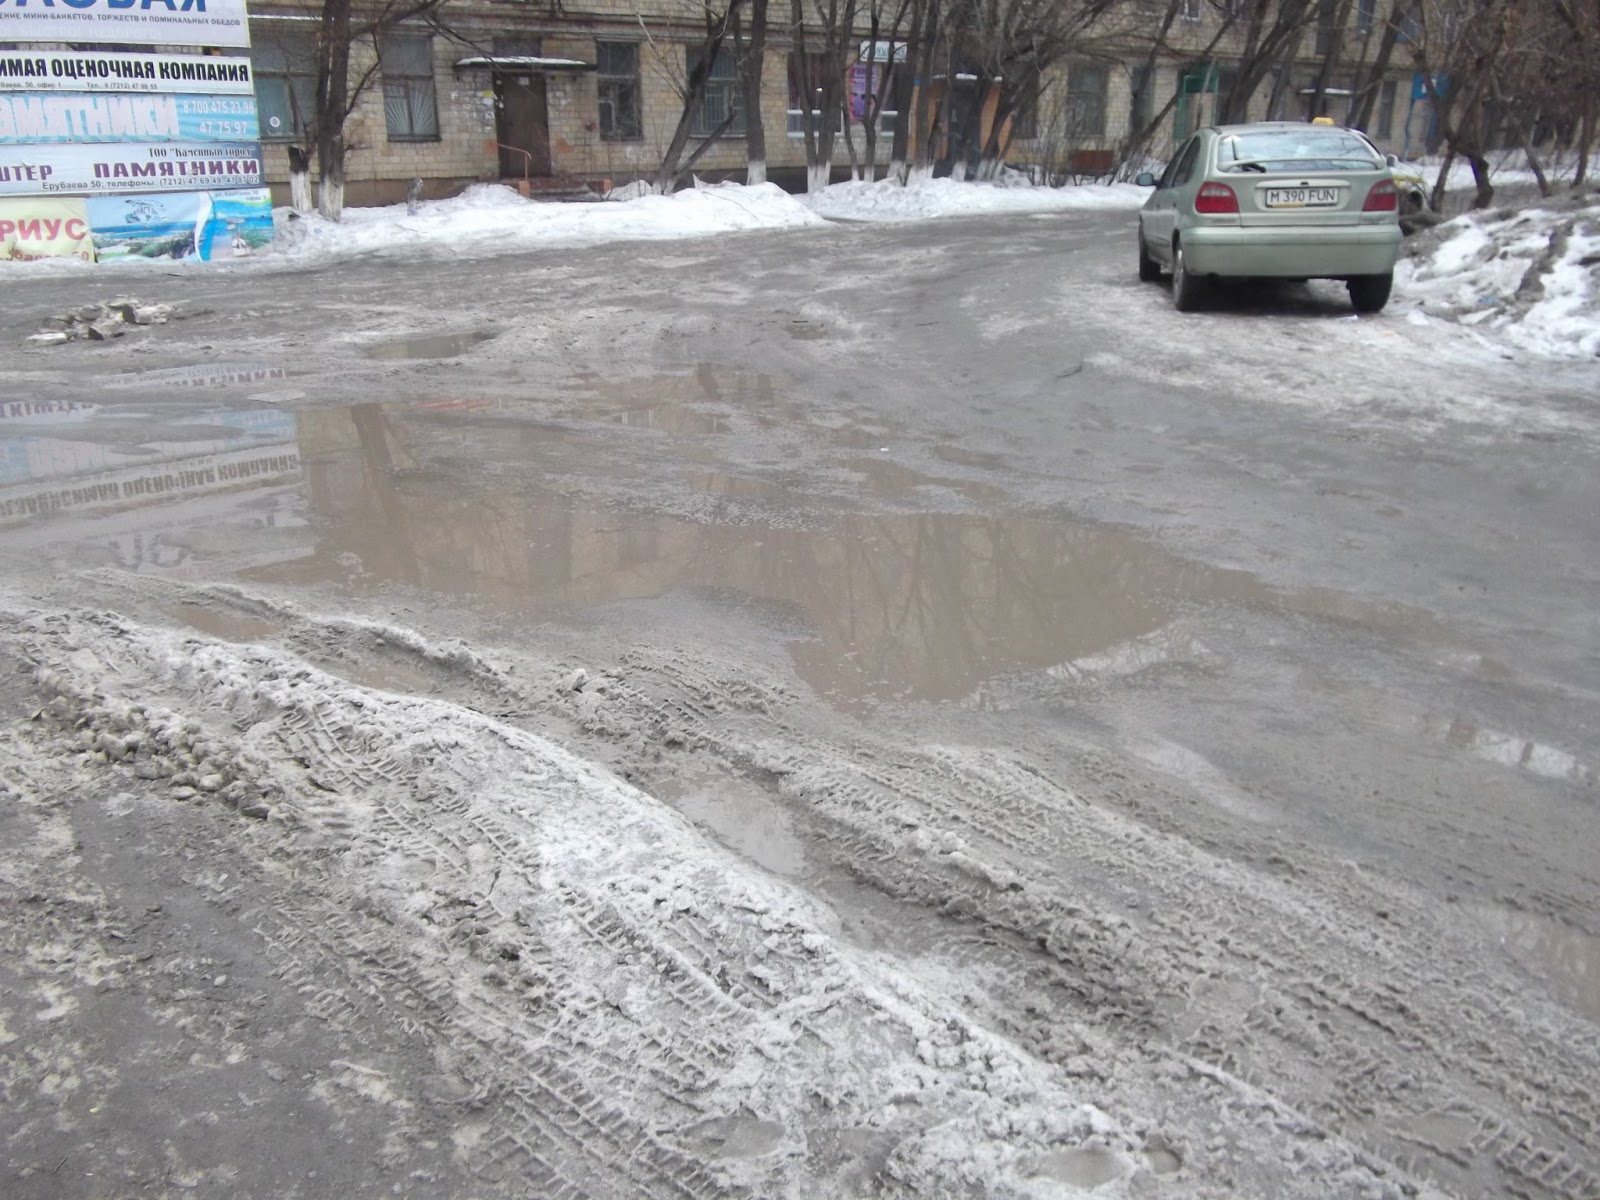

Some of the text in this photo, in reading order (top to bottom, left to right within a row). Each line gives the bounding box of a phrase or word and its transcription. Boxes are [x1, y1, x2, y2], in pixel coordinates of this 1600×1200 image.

[149, 16, 209, 25] ПОМИНАЛЬНЫХ
[211, 18, 241, 26] ОБЕДОВ
[51, 59, 156, 80] ОЦЕНОЧНАЯ
[158, 61, 249, 82] КОМПАНИЯ
[182, 101, 190, 114] 8
[193, 101, 208, 114] 700
[210, 101, 227, 114] 475
[230, 102, 241, 114] 23
[199, 121, 248, 134] 47 75 97
[148, 147, 168, 157] ТОО
[93, 160, 259, 178] ПАМЯТНИКИ
[42, 181, 88, 191] Ерубаева
[160, 178, 186, 187] (7212)
[188, 177, 197, 185] 47
[200, 177, 210, 185] 69
[227, 176, 236, 184] 41
[249, 176, 259, 184] 02
[1270, 189, 1335, 203] M 390 FUN
[0, 218, 87, 242] РИУС
